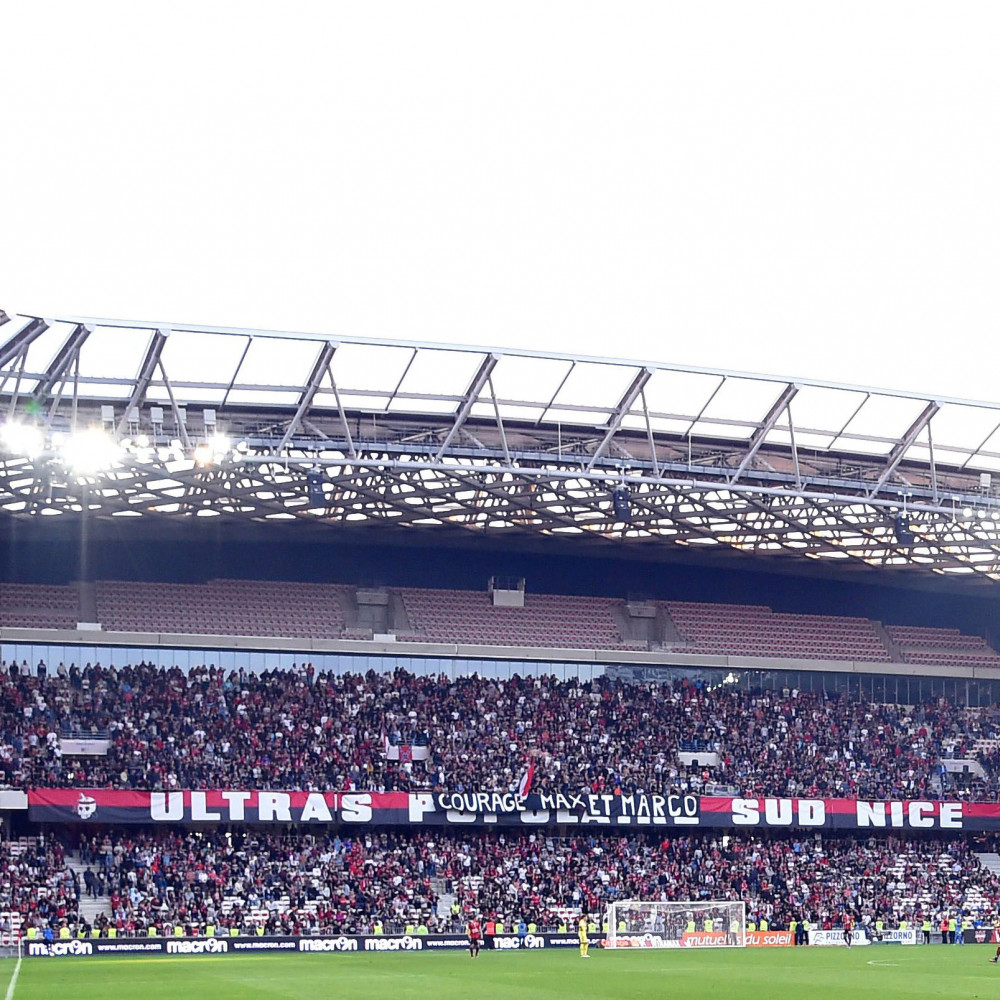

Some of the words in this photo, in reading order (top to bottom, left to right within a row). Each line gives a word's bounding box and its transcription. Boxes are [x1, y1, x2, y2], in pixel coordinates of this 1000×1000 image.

[151, 791, 372, 822] ULTRAS
[438, 793, 526, 812] COURAGE
[541, 794, 586, 809] MAX
[588, 794, 613, 815] ET
[622, 794, 698, 817] MARCO
[731, 798, 825, 826] SUD
[857, 800, 963, 829] NICE
[167, 938, 228, 953] macron
[300, 936, 357, 951] macron
[365, 936, 422, 950] macron
[763, 933, 792, 945] soleil
